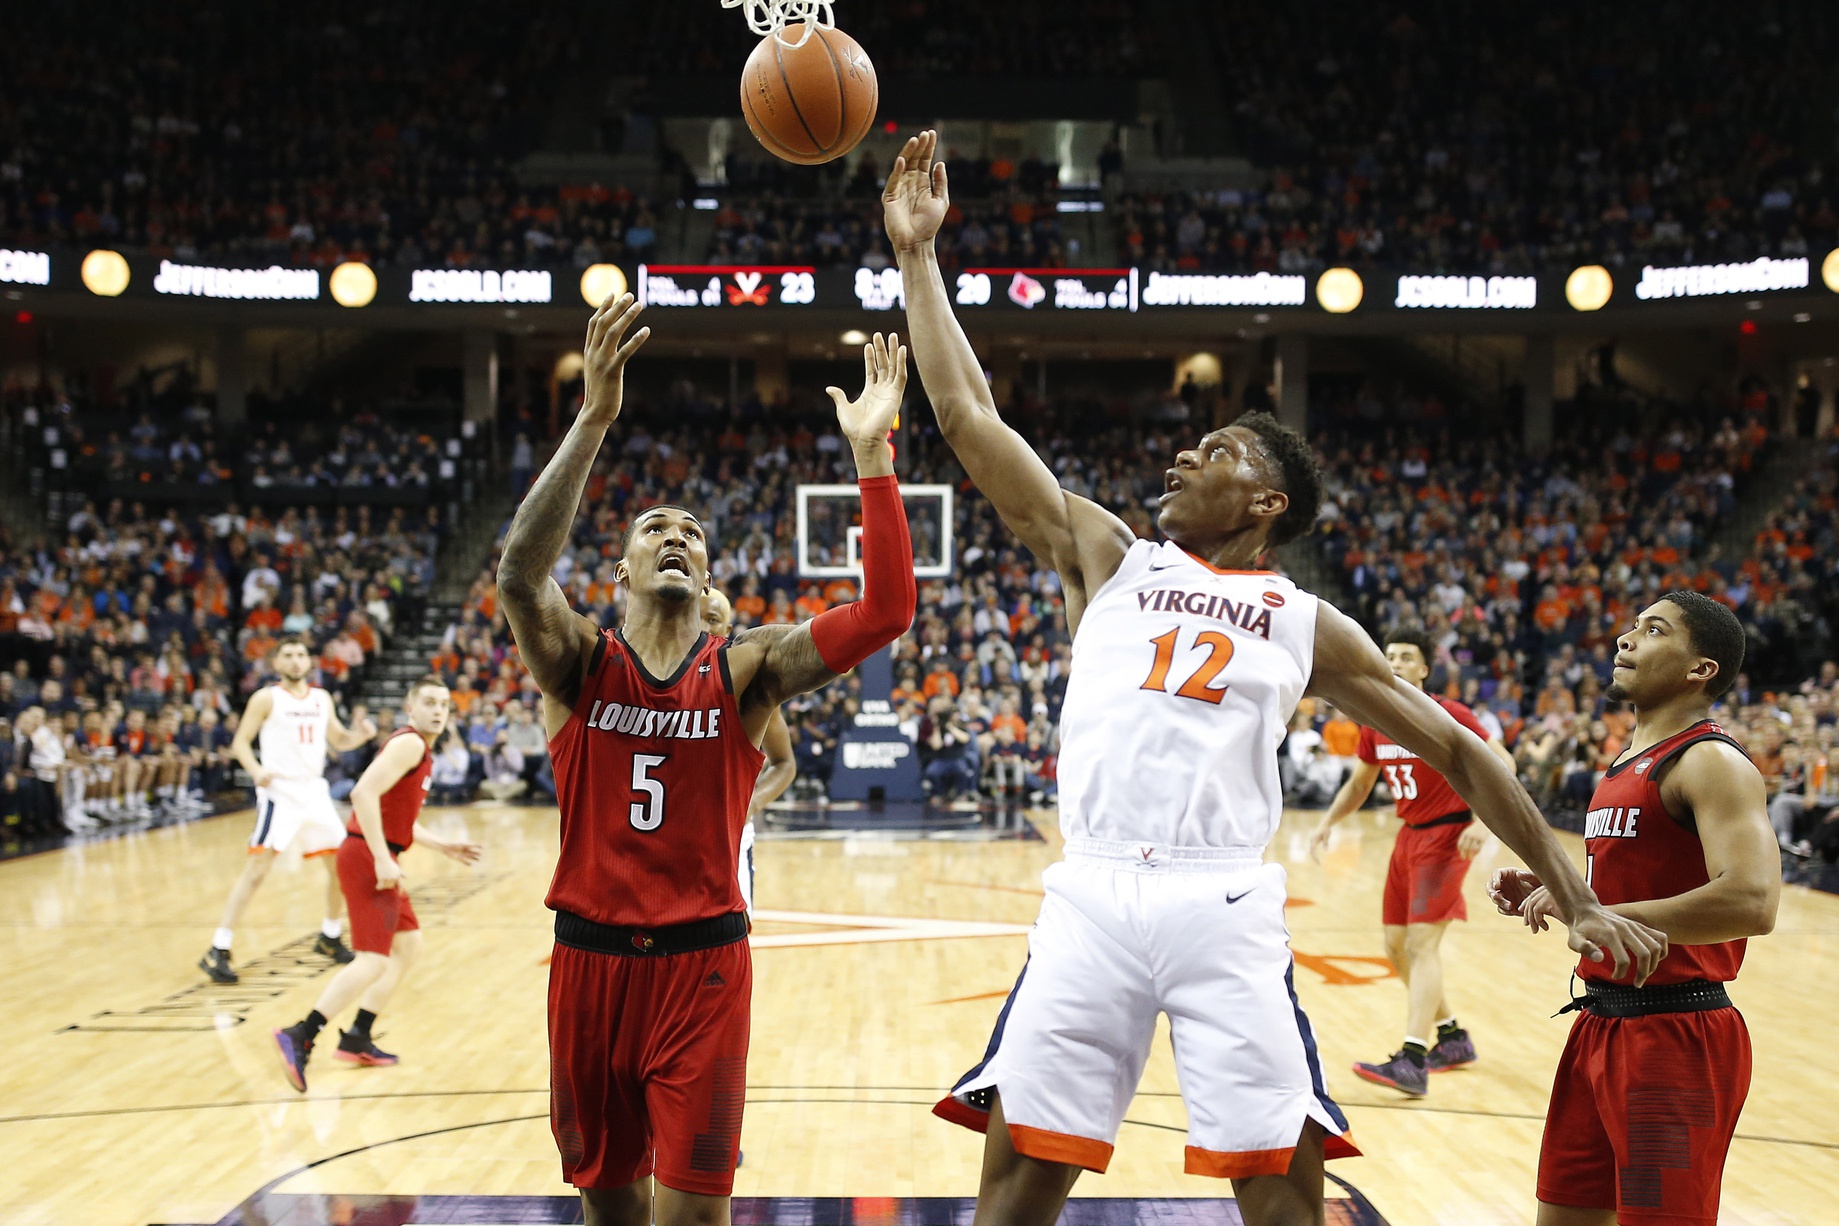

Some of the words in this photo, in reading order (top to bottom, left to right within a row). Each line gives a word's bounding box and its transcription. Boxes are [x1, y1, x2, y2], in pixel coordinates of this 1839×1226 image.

[780, 272, 815, 303] 23
[1137, 589, 1272, 640] VIRGINIA
[1139, 625, 1235, 705] 12
[299, 723, 314, 744] 11
[587, 699, 721, 740] LOUISVILLE
[630, 753, 666, 831] 5
[1385, 764, 1418, 800] 33
